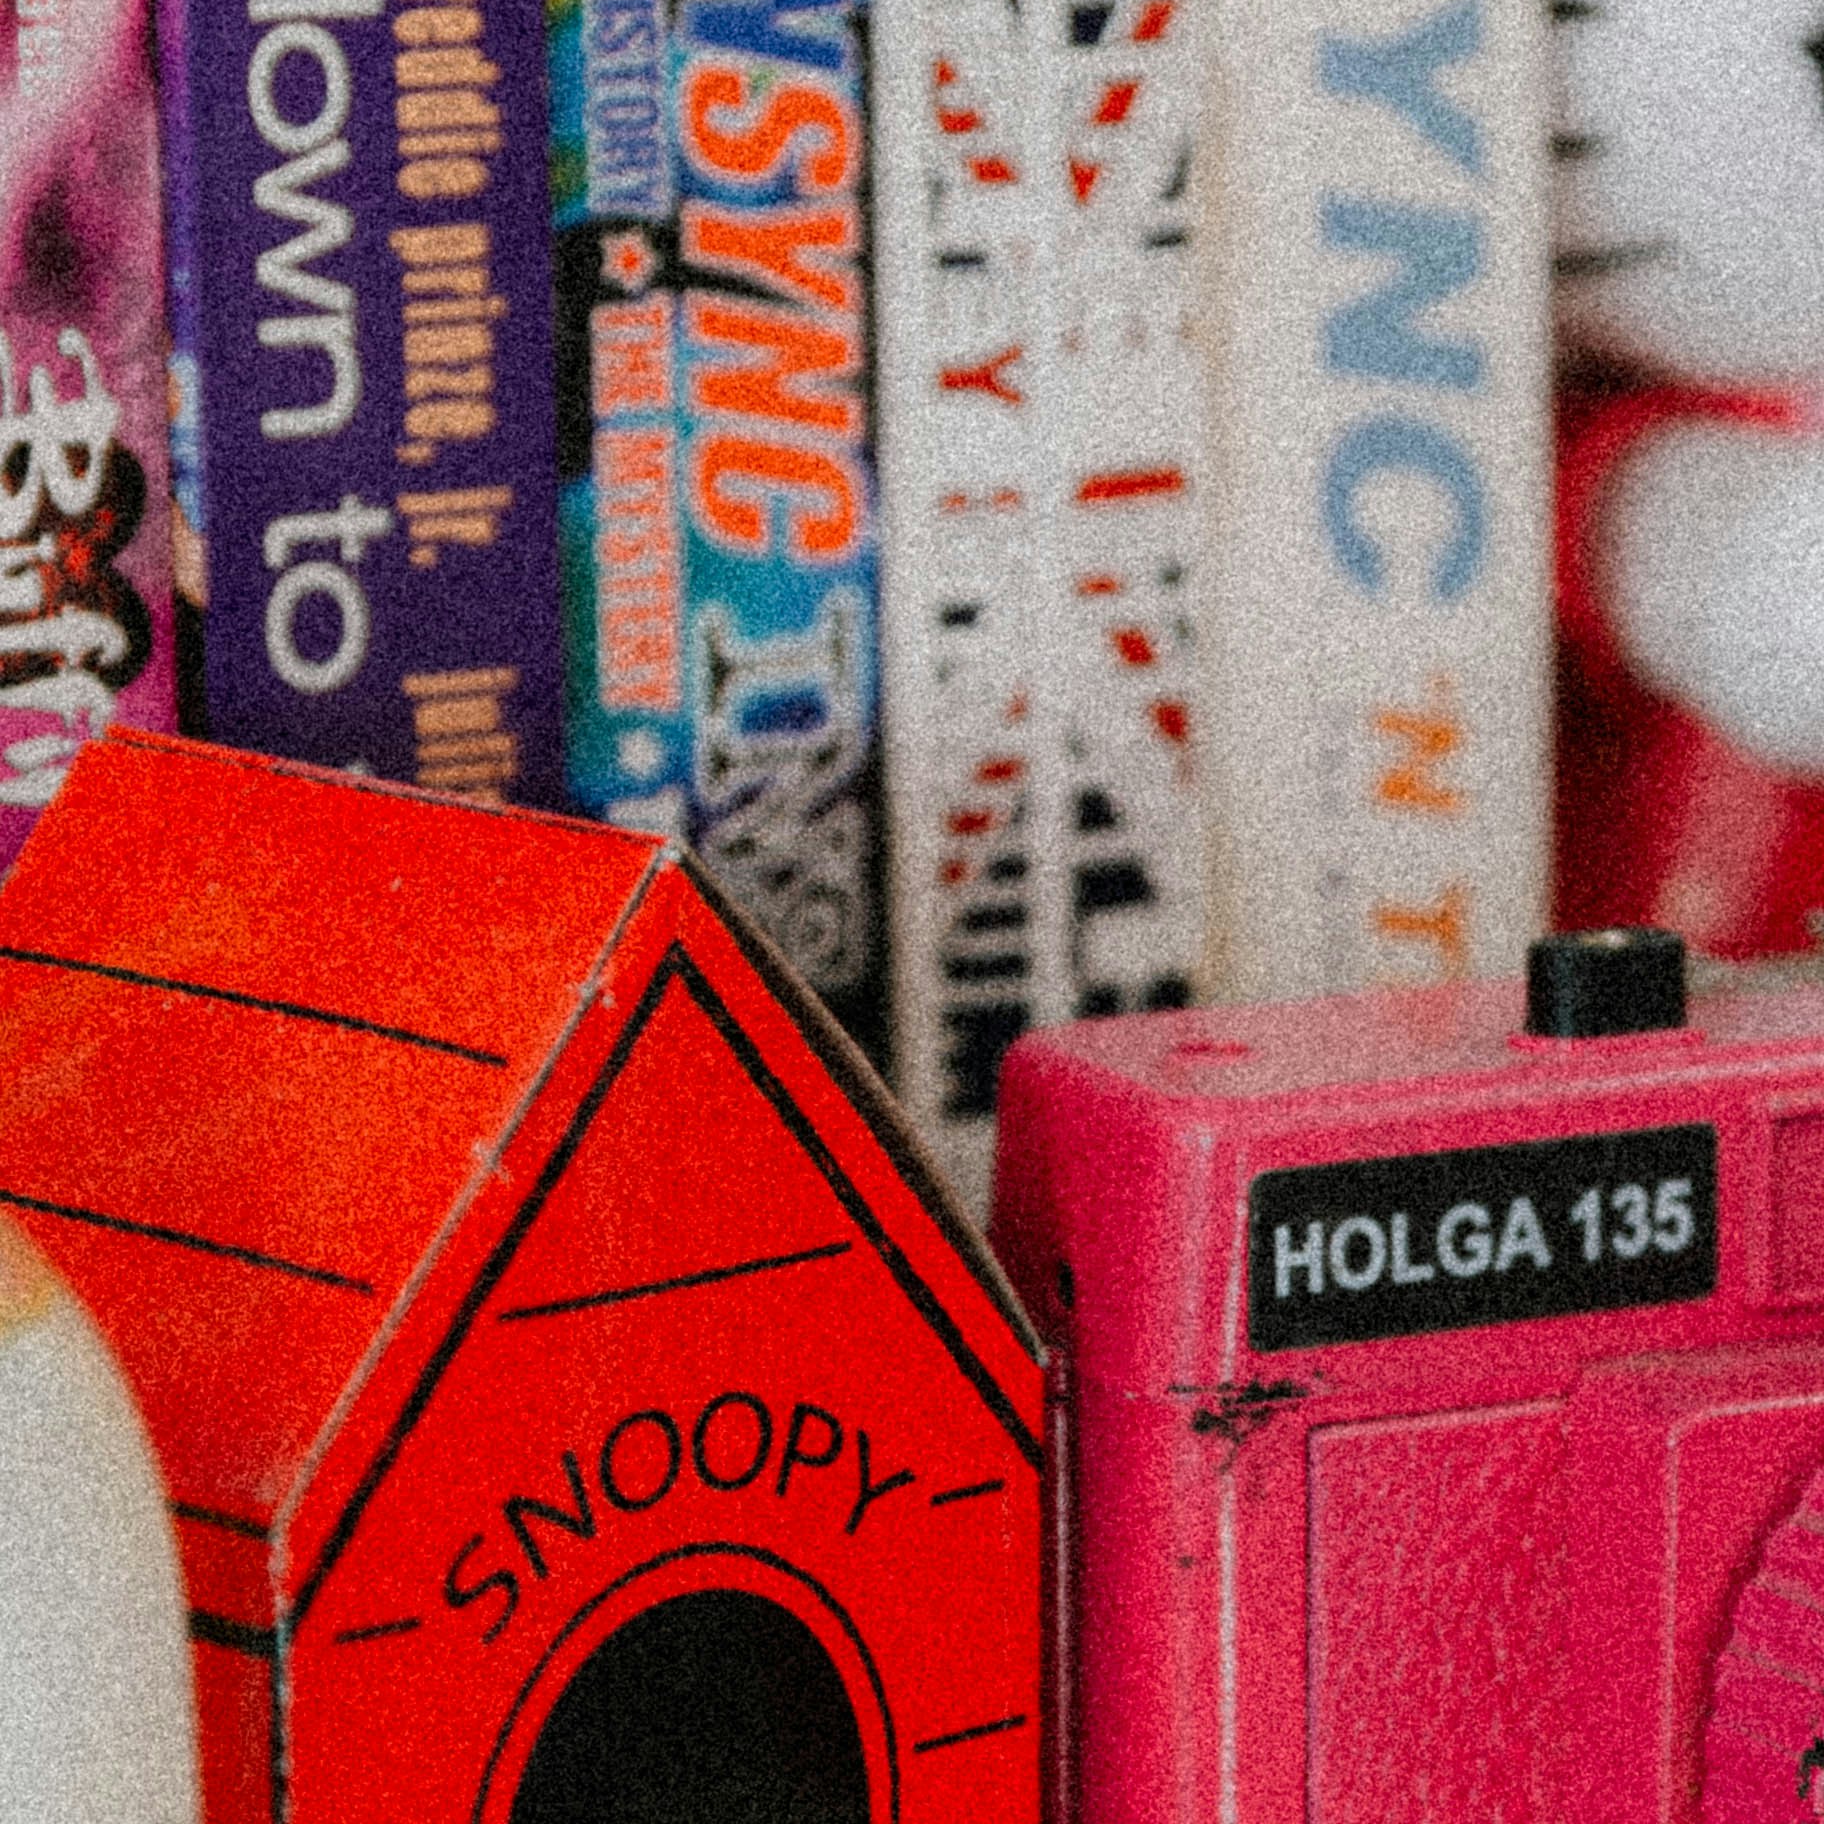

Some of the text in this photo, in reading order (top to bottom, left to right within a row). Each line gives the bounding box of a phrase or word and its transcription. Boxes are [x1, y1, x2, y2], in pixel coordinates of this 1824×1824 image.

[387, 224, 511, 465] prinze,
[596, 299, 671, 417] THE
[0, 328, 130, 808] Buffy
[261, 496, 392, 695] to
[599, 430, 682, 713] MYSTERY
[401, 665, 520, 811] juli
[1275, 1179, 1694, 1298] HOLGA 135
[442, 1390, 917, 1648] SNOOPY
